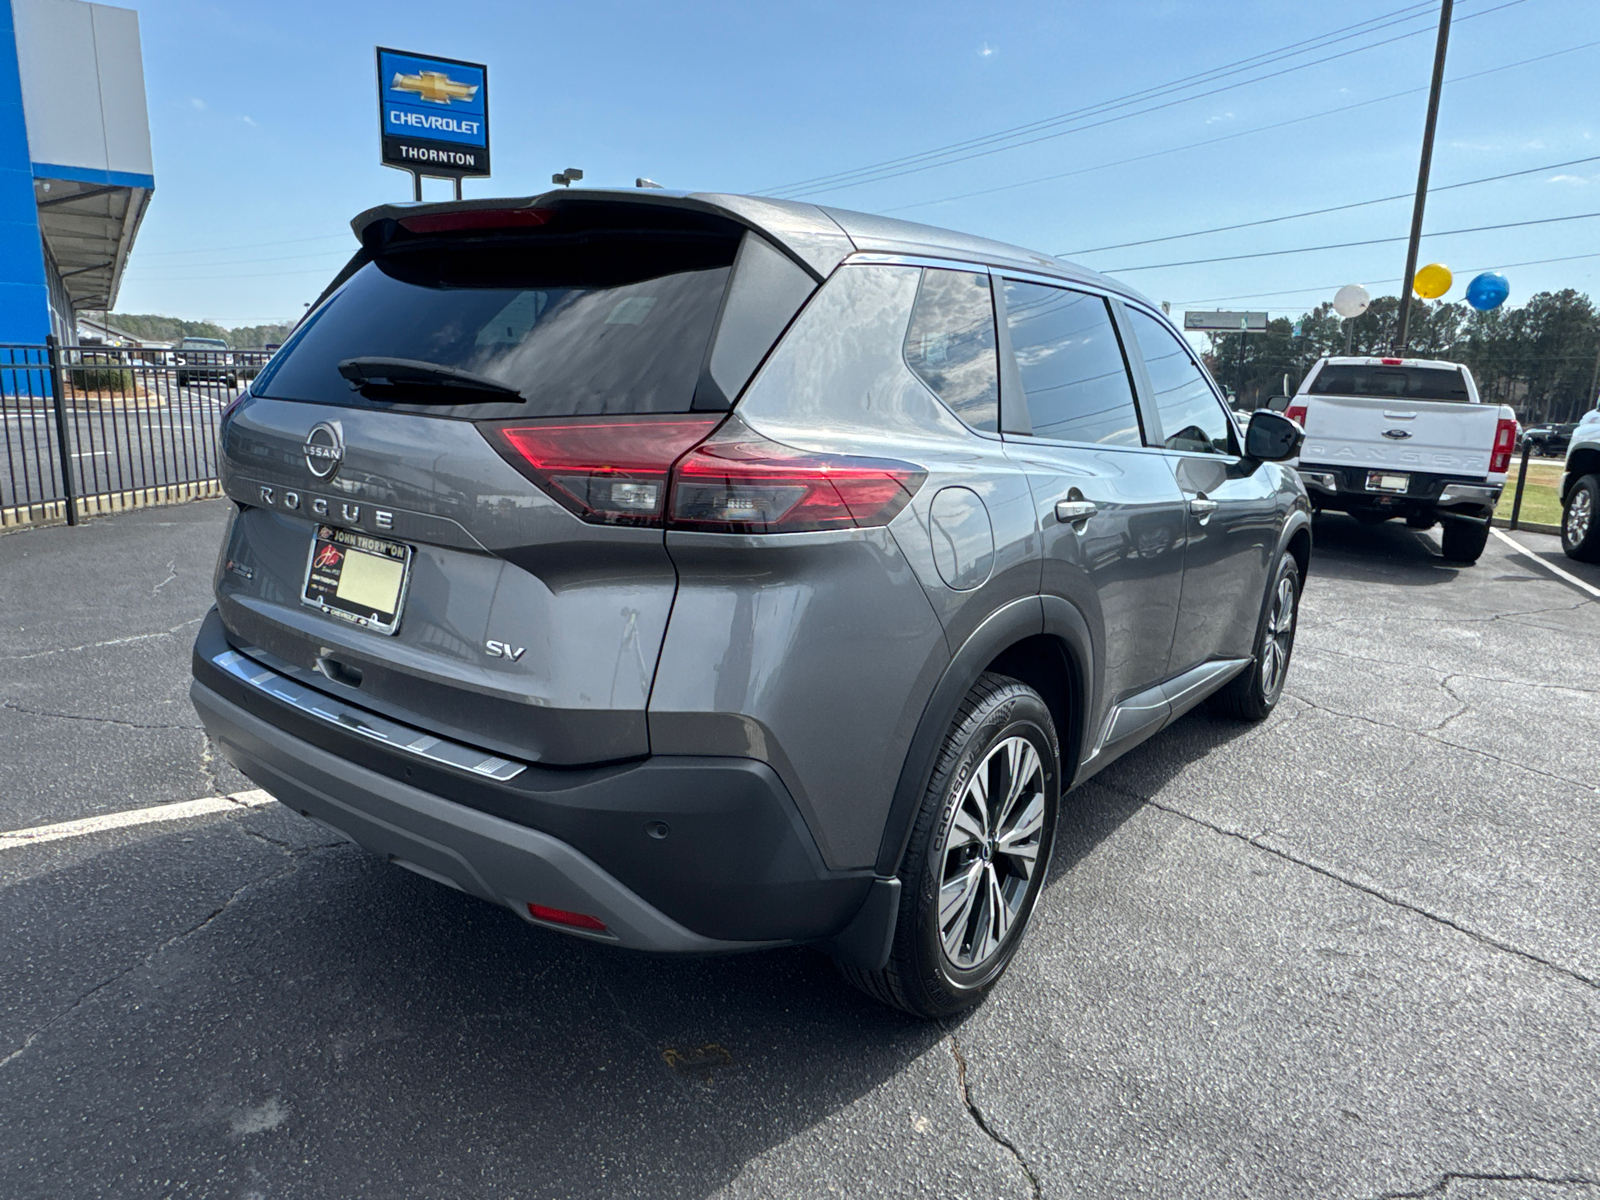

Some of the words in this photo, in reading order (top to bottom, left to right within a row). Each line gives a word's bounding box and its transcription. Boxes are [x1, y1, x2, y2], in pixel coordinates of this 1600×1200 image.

[390, 110, 480, 135] CHEVROLET
[399, 145, 475, 166] THORNTON
[1307, 444, 1485, 468] RANGER
[259, 486, 394, 530] ROGUE
[334, 531, 357, 546] JOHN
[485, 639, 528, 662] SV
